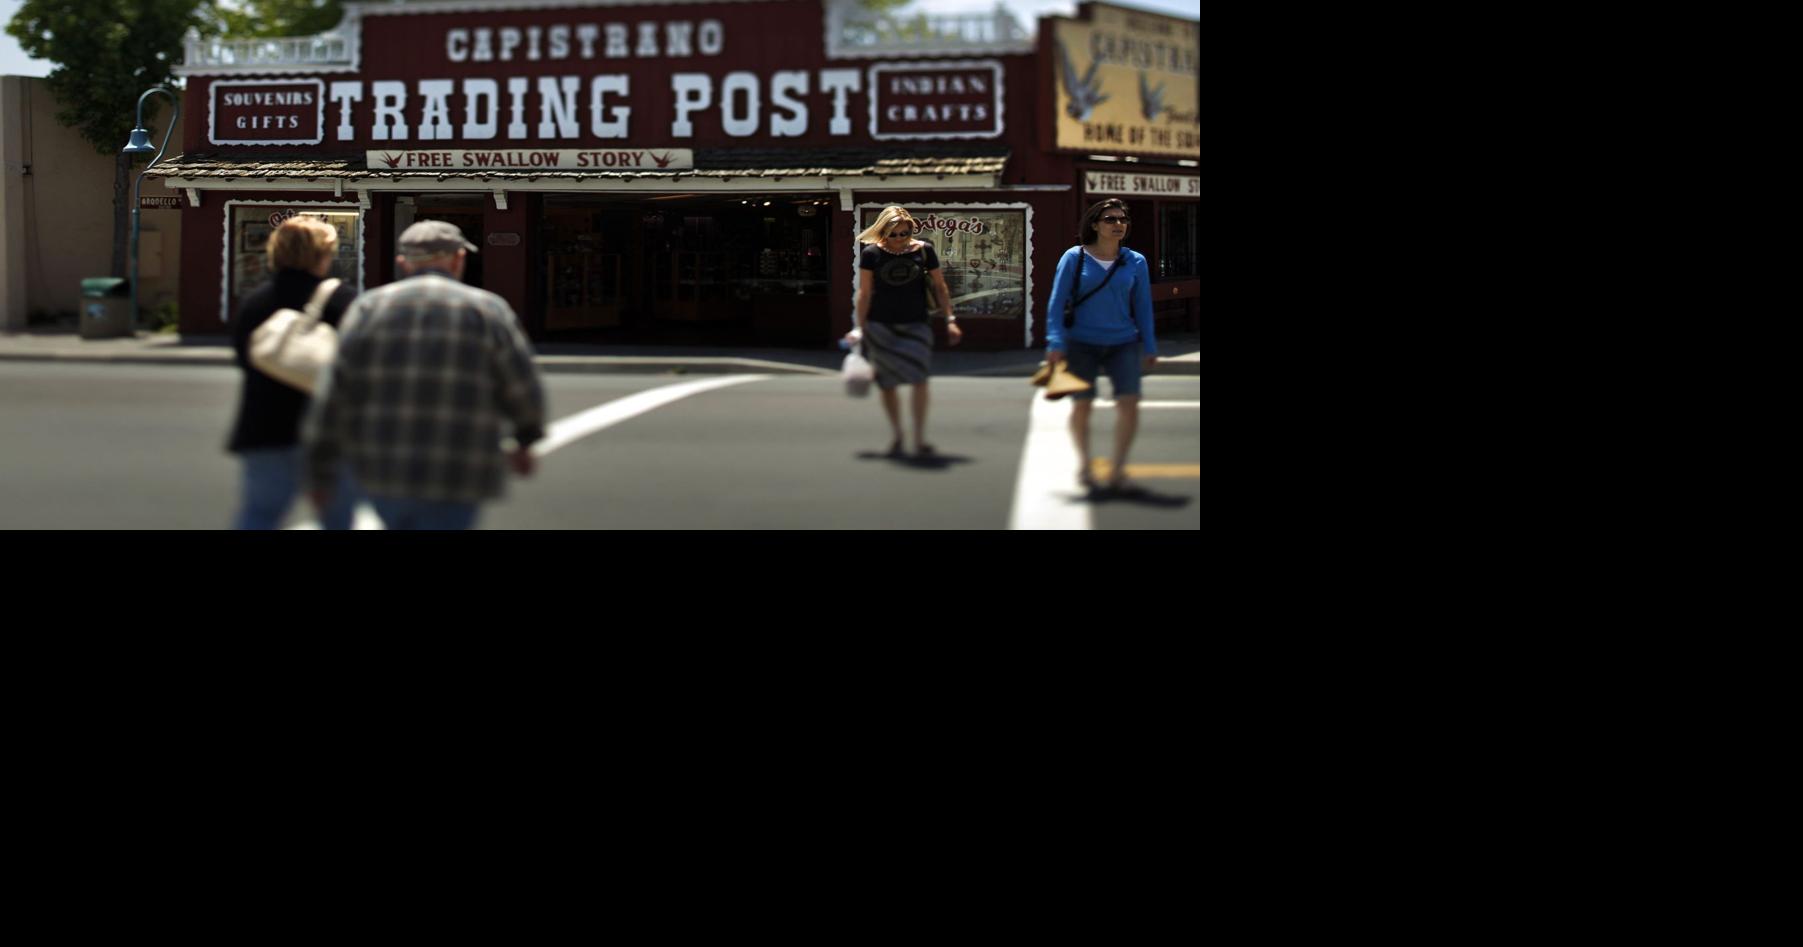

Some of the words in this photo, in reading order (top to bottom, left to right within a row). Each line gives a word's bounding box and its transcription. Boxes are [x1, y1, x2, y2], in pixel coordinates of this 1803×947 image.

[448, 22, 722, 61] CAPISTRANO
[890, 75, 987, 95] INDIAN
[223, 91, 313, 106] SOUVENIRS
[331, 75, 631, 140] TRADING
[671, 70, 861, 137] POST
[236, 115, 299, 129] GIFTS
[887, 103, 988, 122] CRAFTS
[1083, 123, 1123, 144] HOME
[1129, 126, 1145, 144] OF
[1150, 127, 1171, 147] THE
[406, 152, 453, 167] FREE
[462, 151, 559, 168] SWALLOW
[577, 151, 644, 167] STORY
[1101, 174, 1126, 191] FREE
[1133, 176, 1180, 193] SWALLOW
[912, 213, 984, 237] rtega's
